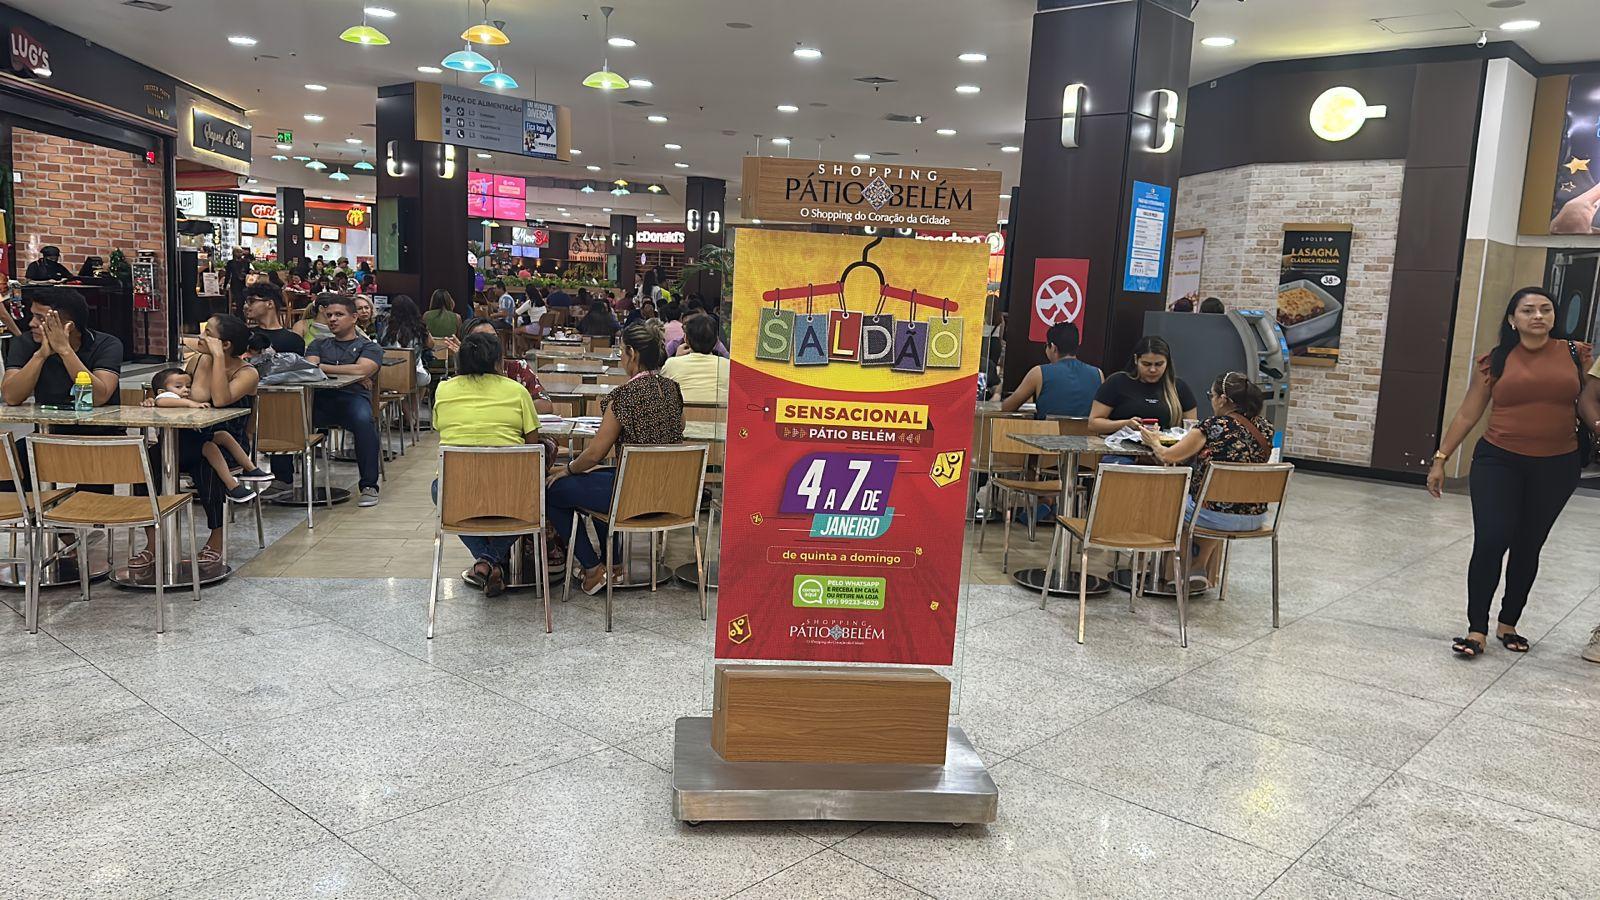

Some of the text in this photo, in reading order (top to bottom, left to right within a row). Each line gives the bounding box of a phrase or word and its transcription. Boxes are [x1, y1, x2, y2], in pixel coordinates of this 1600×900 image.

[11, 33, 50, 70] LUG'S
[443, 93, 466, 103] PRAÇA
[478, 100, 522, 113] ALIMENTAÇÃO
[818, 163, 938, 181] SHOPPING
[785, 172, 973, 211] PÁTIO BELÉM
[800, 208, 950, 225] O Shopping do Coração da Cidade
[1291, 247, 1340, 257] LASAGNA
[762, 319, 959, 368] SALDÃO
[784, 404, 923, 425] SENSACIONAL
[809, 426, 896, 442] PÁTIO BELÉM
[797, 459, 882, 511] 4 A 7 DE
[820, 516, 880, 537] JANEIRO
[782, 550, 797, 560] de
[800, 551, 837, 564] quinta
[850, 552, 901, 565] domingo
[790, 622, 885, 640] PÁTIO BELÉM
[806, 619, 867, 627] SHOPPING
